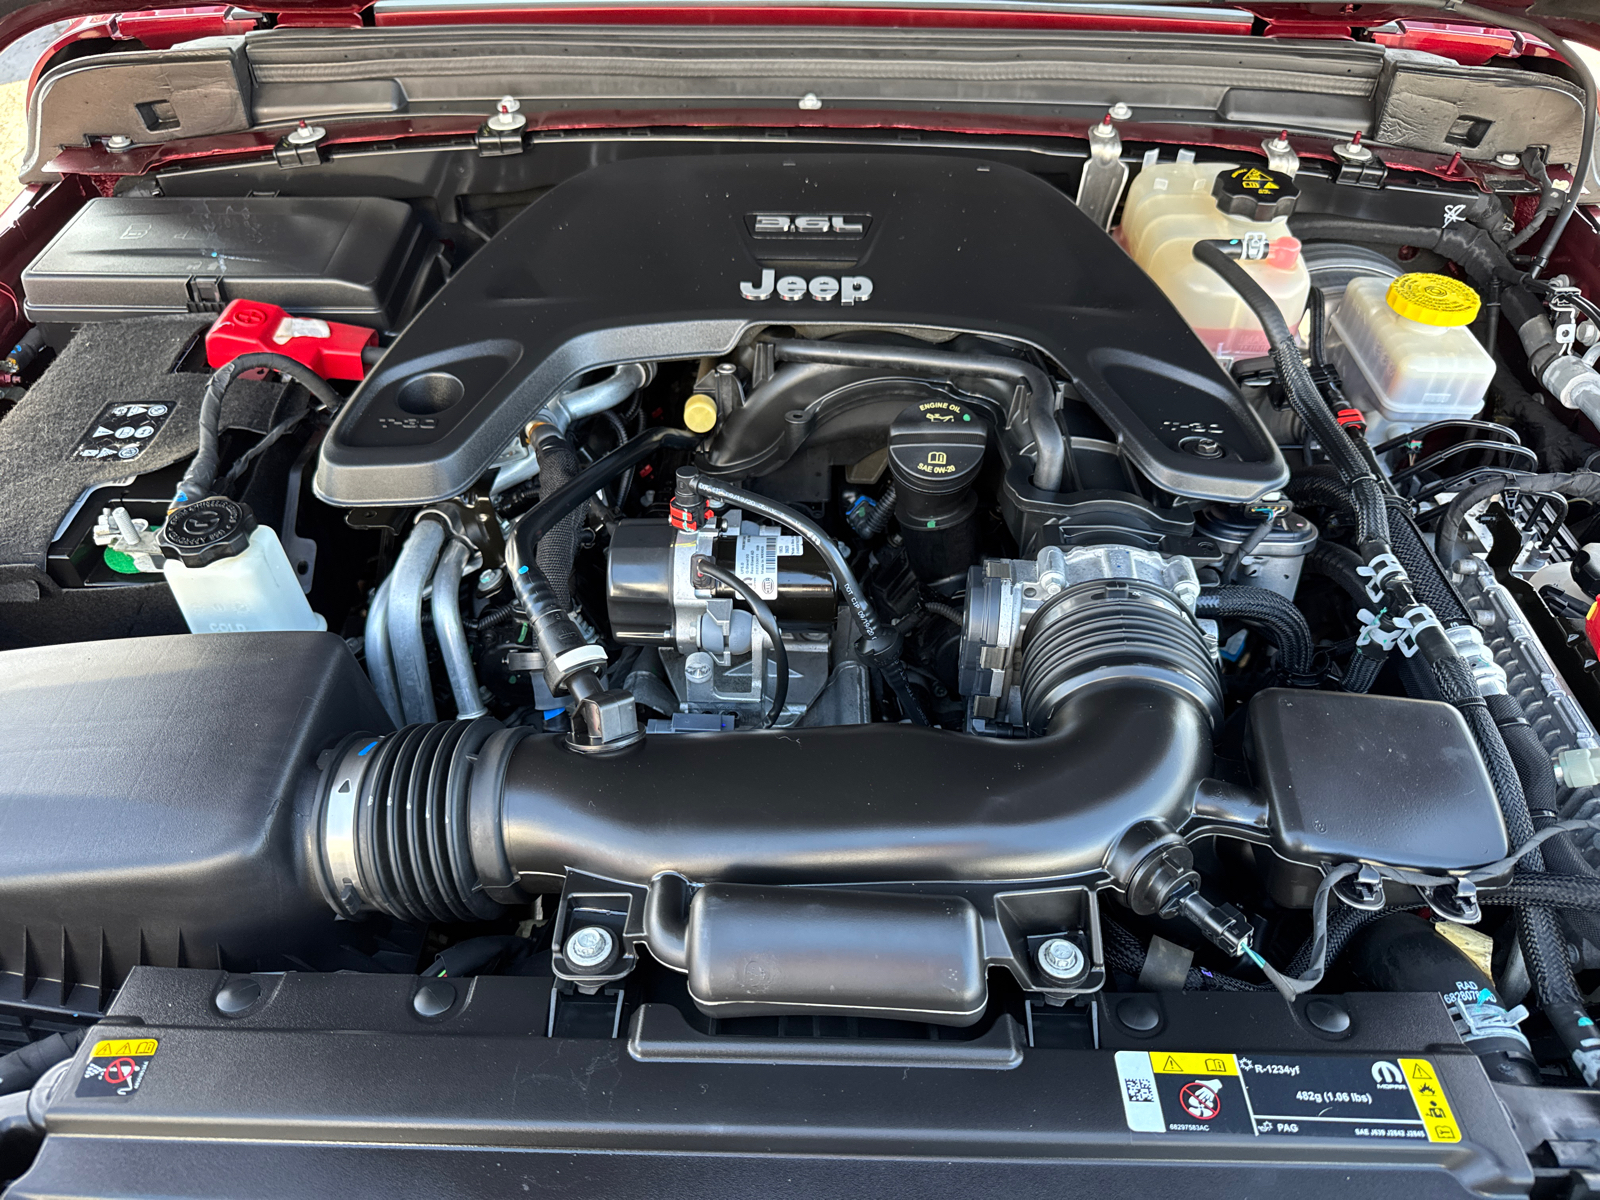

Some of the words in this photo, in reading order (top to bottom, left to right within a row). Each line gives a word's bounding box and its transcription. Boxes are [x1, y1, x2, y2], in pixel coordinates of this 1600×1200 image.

[755, 215, 863, 232] 3.6L
[740, 268, 874, 306] Jeep
[919, 402, 948, 411] ENGINE
[949, 404, 961, 413] OIL
[917, 462, 933, 473] SAE
[844, 583, 854, 596] DOT
[1455, 981, 1478, 990] RAD
[1255, 1064, 1300, 1076] R-1234yf
[1296, 1090, 1322, 1103] 482g
[1323, 1092, 1350, 1103] (1.06
[1351, 1092, 1372, 1105] lbs)
[1277, 1123, 1299, 1133] PAG
[1354, 1128, 1370, 1136] SAE
